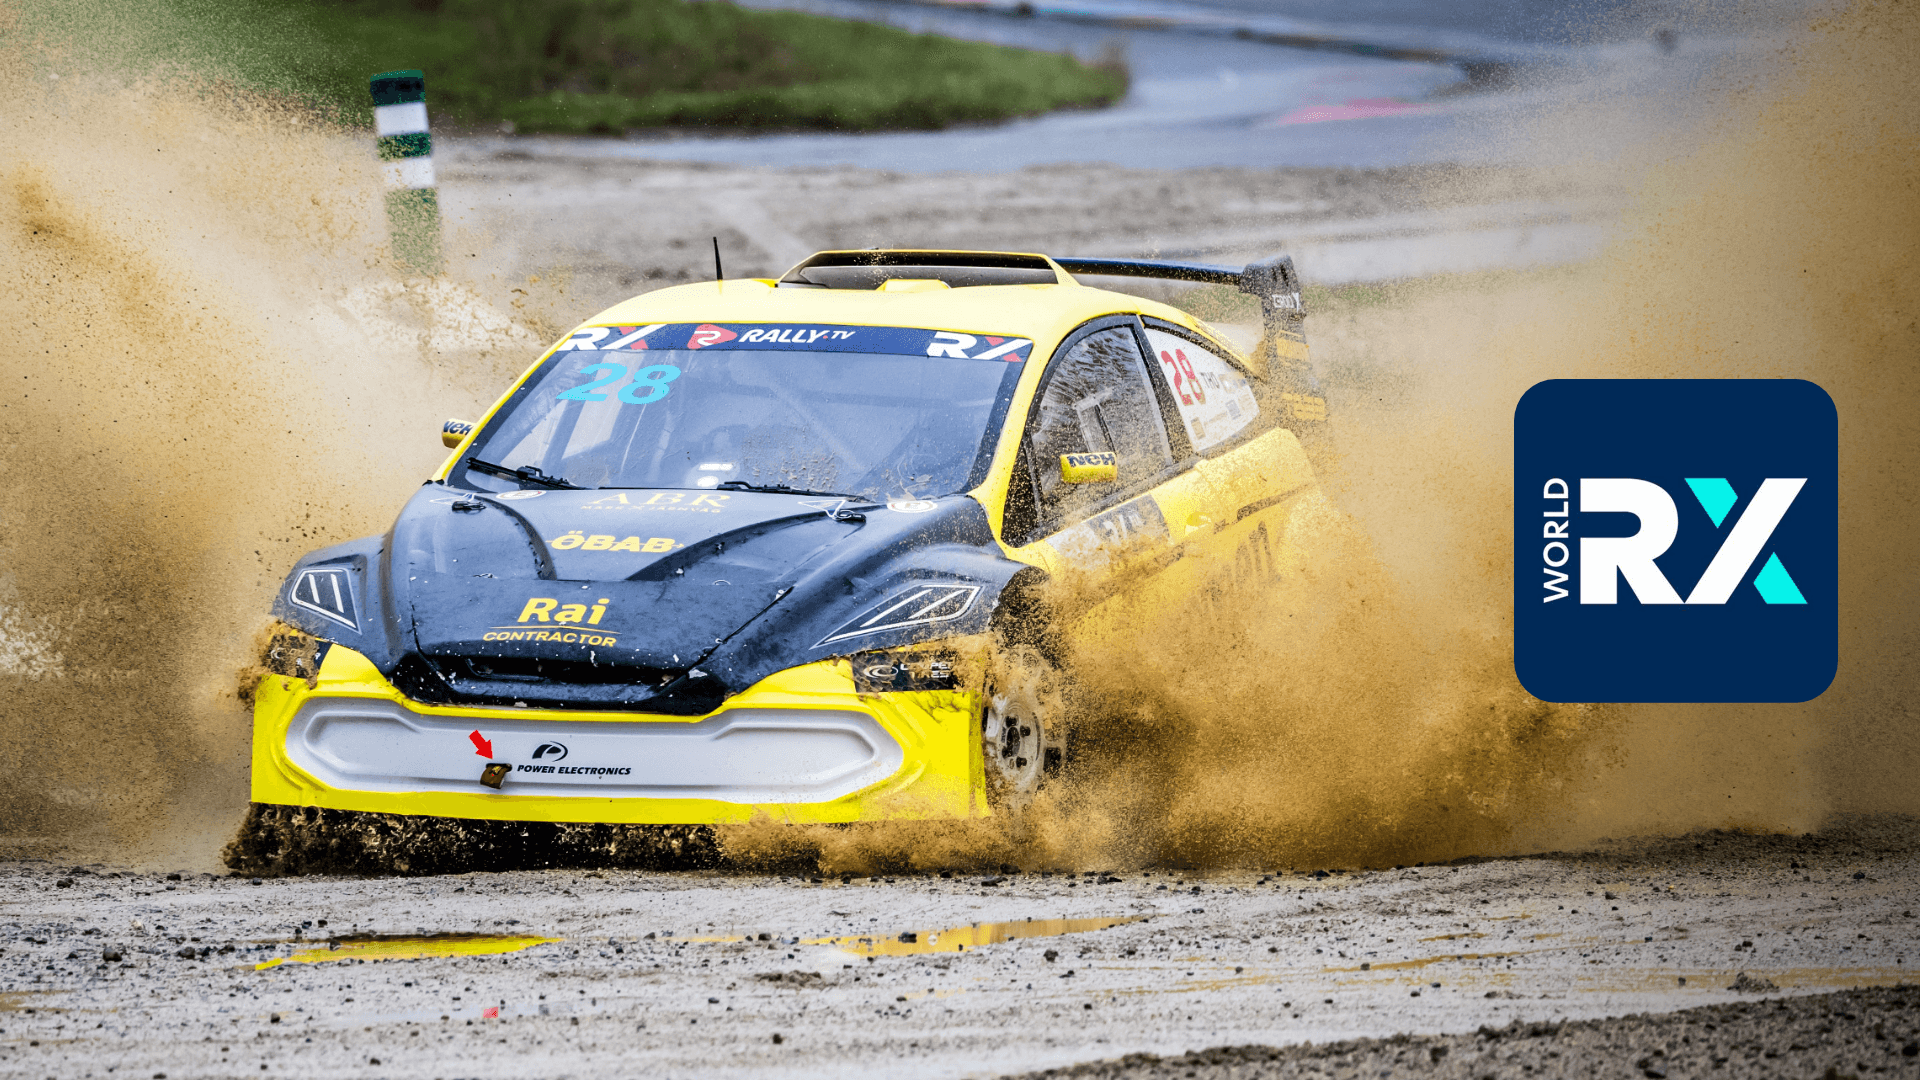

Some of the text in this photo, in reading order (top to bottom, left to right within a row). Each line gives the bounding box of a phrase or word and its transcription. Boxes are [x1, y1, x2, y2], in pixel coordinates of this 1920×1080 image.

[555, 324, 667, 351] RX
[926, 331, 1033, 362] RX
[556, 362, 681, 404] 28
[1160, 348, 1207, 406] 28
[1067, 453, 1116, 467] NCH
[587, 492, 732, 508] ABR
[551, 530, 676, 553] ÖBAB
[517, 597, 610, 625] Rai
[483, 631, 618, 648] CONTRACTOR
[517, 764, 631, 776] POWER ELECTRONICS
